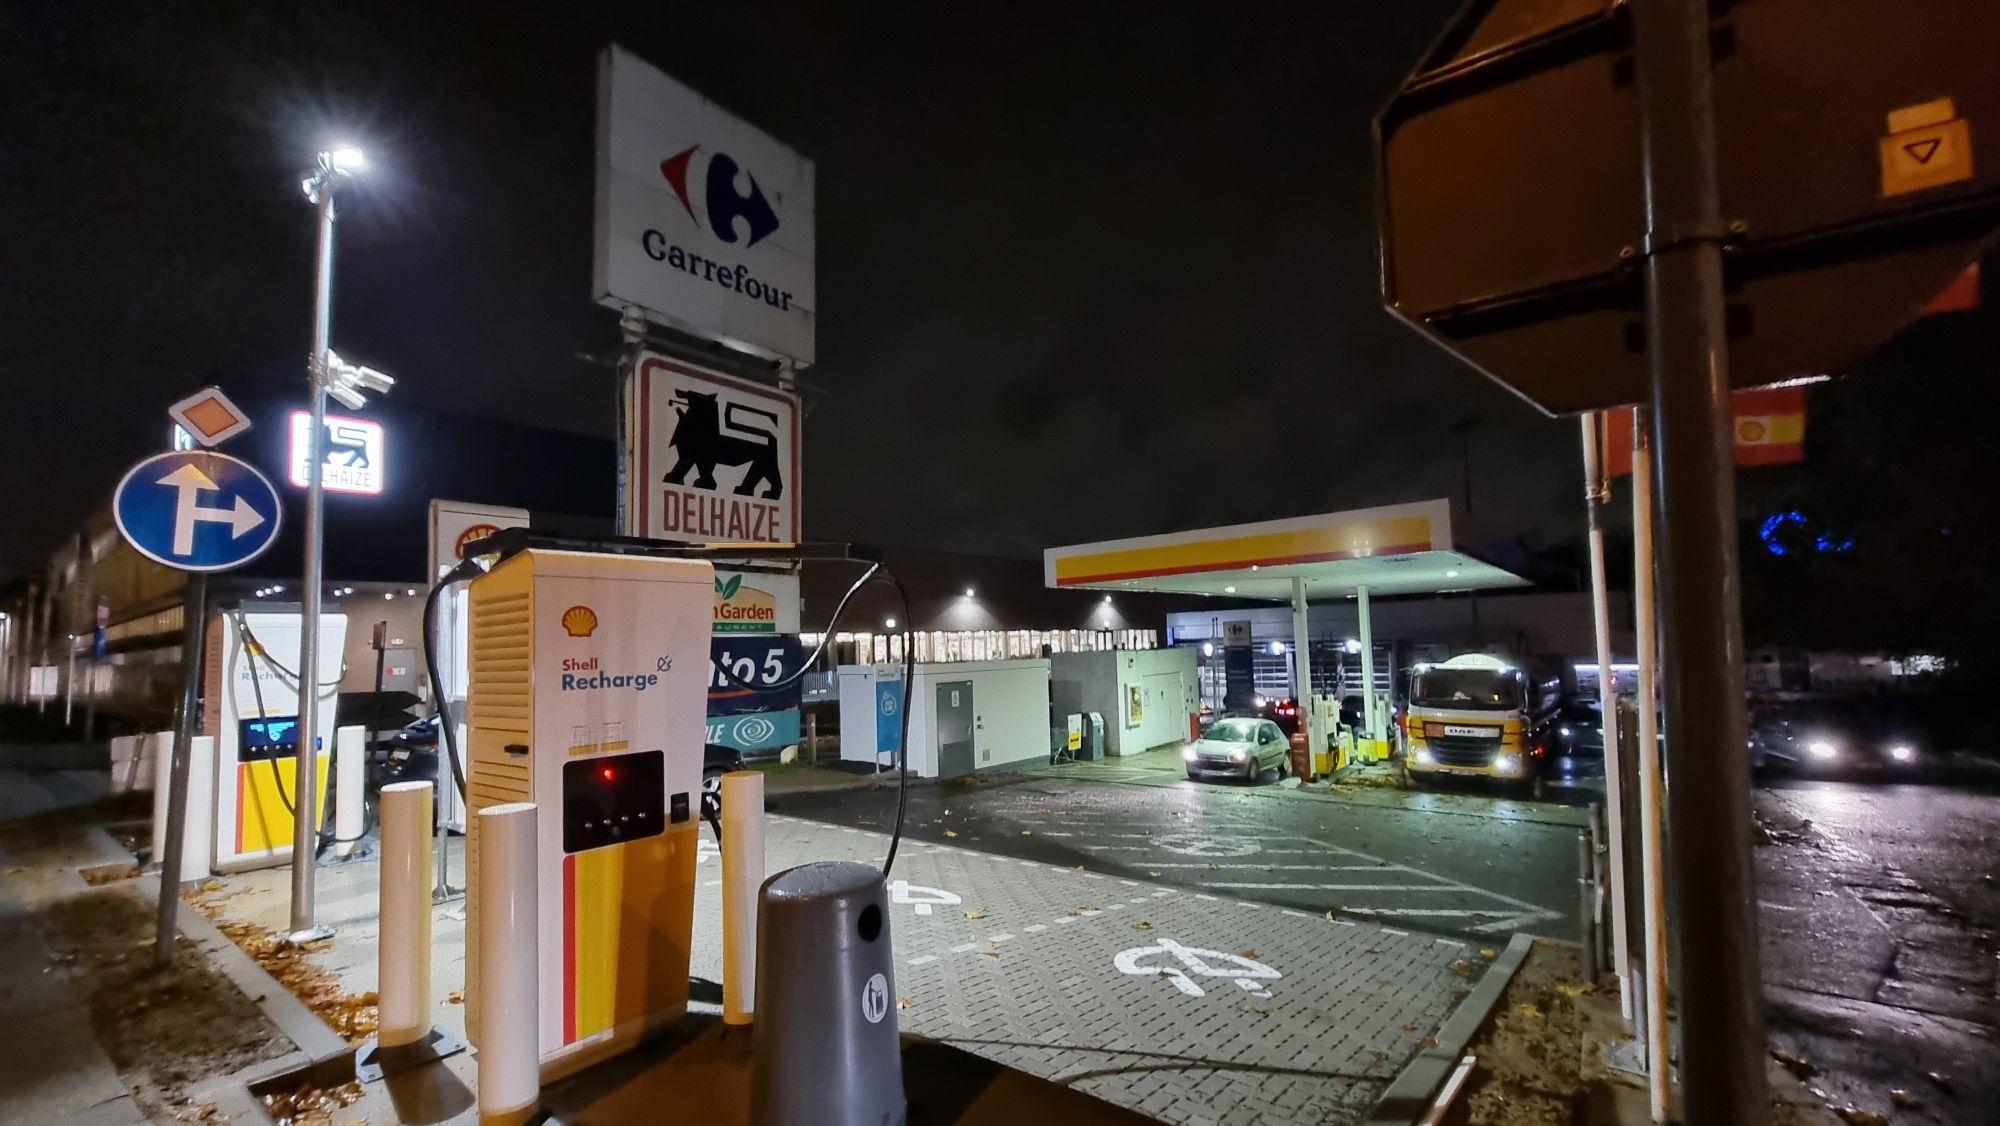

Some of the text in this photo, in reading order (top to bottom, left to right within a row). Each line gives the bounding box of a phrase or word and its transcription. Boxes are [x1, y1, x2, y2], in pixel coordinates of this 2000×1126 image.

[642, 229, 793, 311] Carrefour
[663, 489, 780, 543] DELHAIZE
[720, 603, 774, 620] Garden
[562, 657, 598, 671] Shell
[761, 648, 784, 684] 5
[562, 671, 658, 691] Recharge
